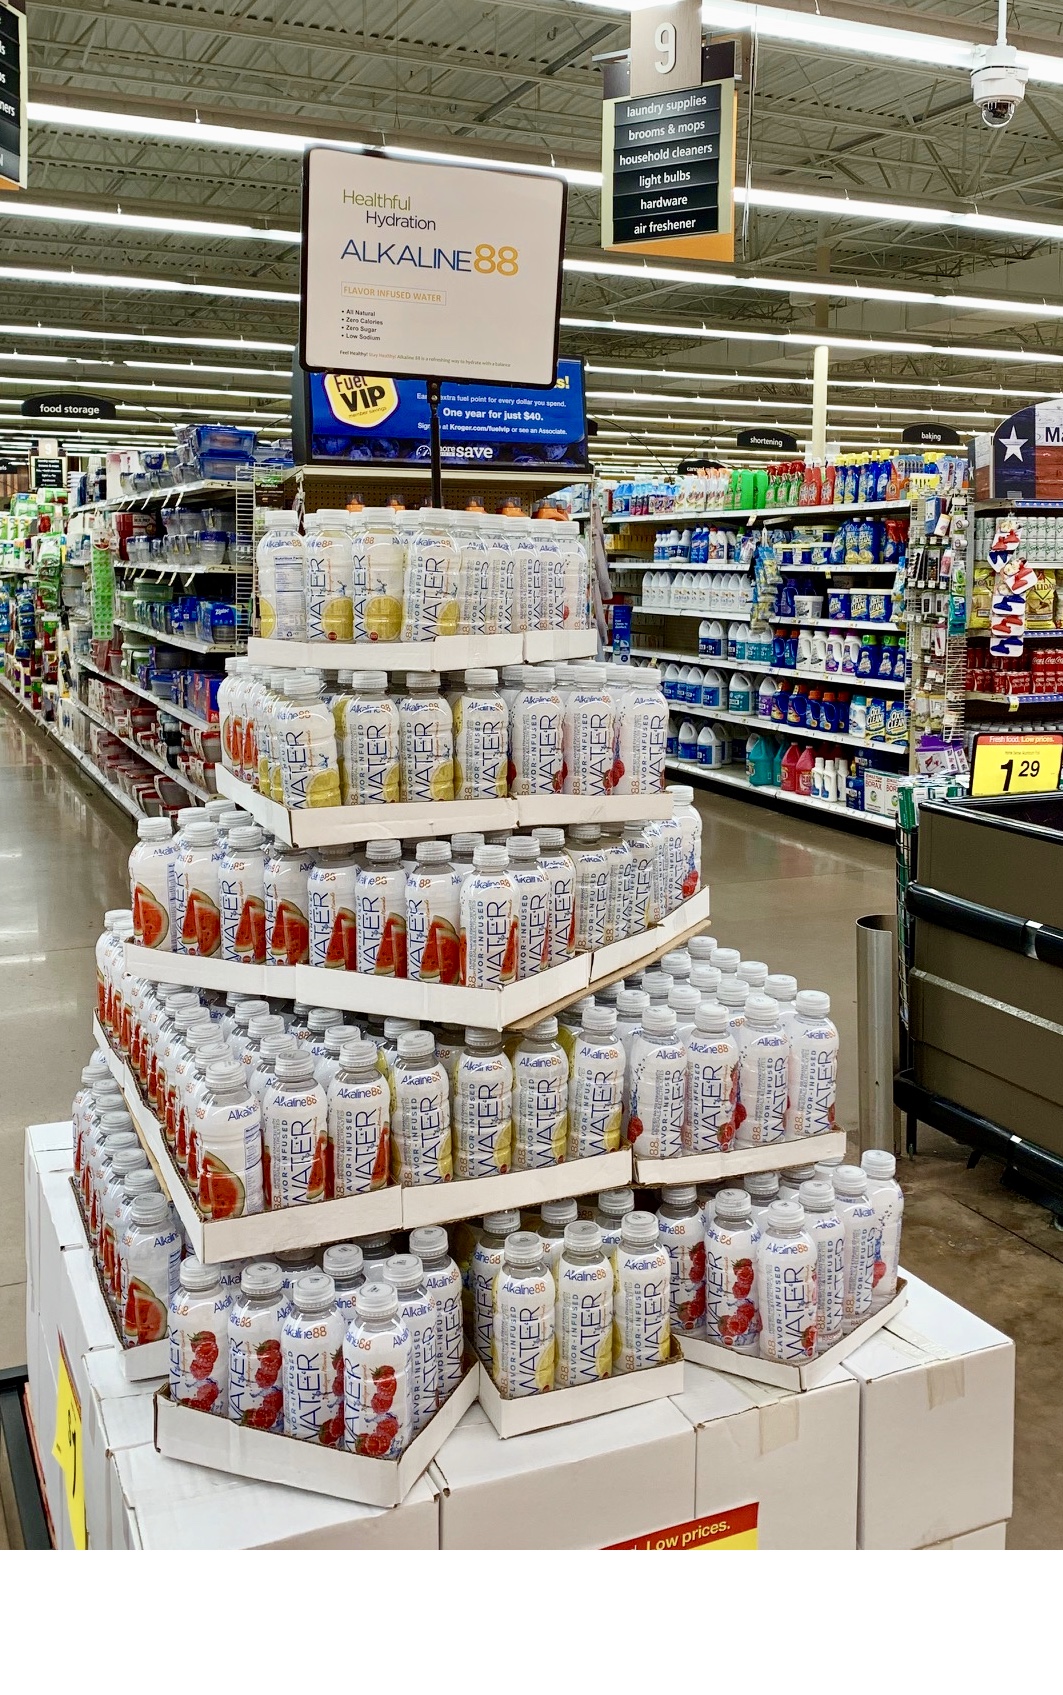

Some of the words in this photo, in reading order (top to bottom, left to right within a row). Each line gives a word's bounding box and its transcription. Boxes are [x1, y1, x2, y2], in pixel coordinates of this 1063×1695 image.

[654, 22, 676, 74] 9
[627, 102, 664, 117] laundry
[666, 96, 707, 112] supplies
[629, 126, 665, 140] brooms
[668, 124, 676, 134] &
[678, 121, 705, 136] mops
[619, 149, 669, 166] household
[672, 143, 712, 159] cleaners
[639, 176, 661, 188] light
[664, 170, 690, 183] bulbs
[343, 189, 410, 210] Healthful
[640, 196, 688, 209] hardware
[366, 210, 435, 230] Hydration
[634, 225, 647, 235] air
[649, 219, 696, 232] freshener
[344, 286, 374, 295] FLAVOR
[377, 290, 410, 299] INFUSED
[413, 293, 441, 302] WATER
[334, 374, 367, 392] Fuel
[340, 386, 385, 412] VIP
[40, 404, 61, 413] food
[64, 406, 99, 415] storage
[443, 408, 462, 416] One
[465, 411, 485, 419] year
[488, 409, 501, 418] for
[504, 412, 521, 420] just
[524, 412, 543, 420] $40.
[450, 424, 510, 433] Kroger.com/fuelvip
[921, 432, 942, 441] baking
[750, 436, 783, 447] shortening
[456, 447, 493, 458] save
[1001, 760, 1013, 791] 1
[1018, 760, 1040, 777] 29
[814, 1049, 834, 1134] WATER
[588, 1071, 614, 1156] WATER
[701, 1065, 723, 1151] WATER
[478, 1083, 499, 1177] WATER
[536, 1078, 558, 1168] WATER
[564, 1268, 607, 1282] Alkaline88
[502, 1282, 546, 1295] Alkaline88
[784, 1266, 807, 1359] WATER
[413, 1330, 421, 1431] FLAVOR-INFUSED
[682, 1520, 731, 1547] prices.
